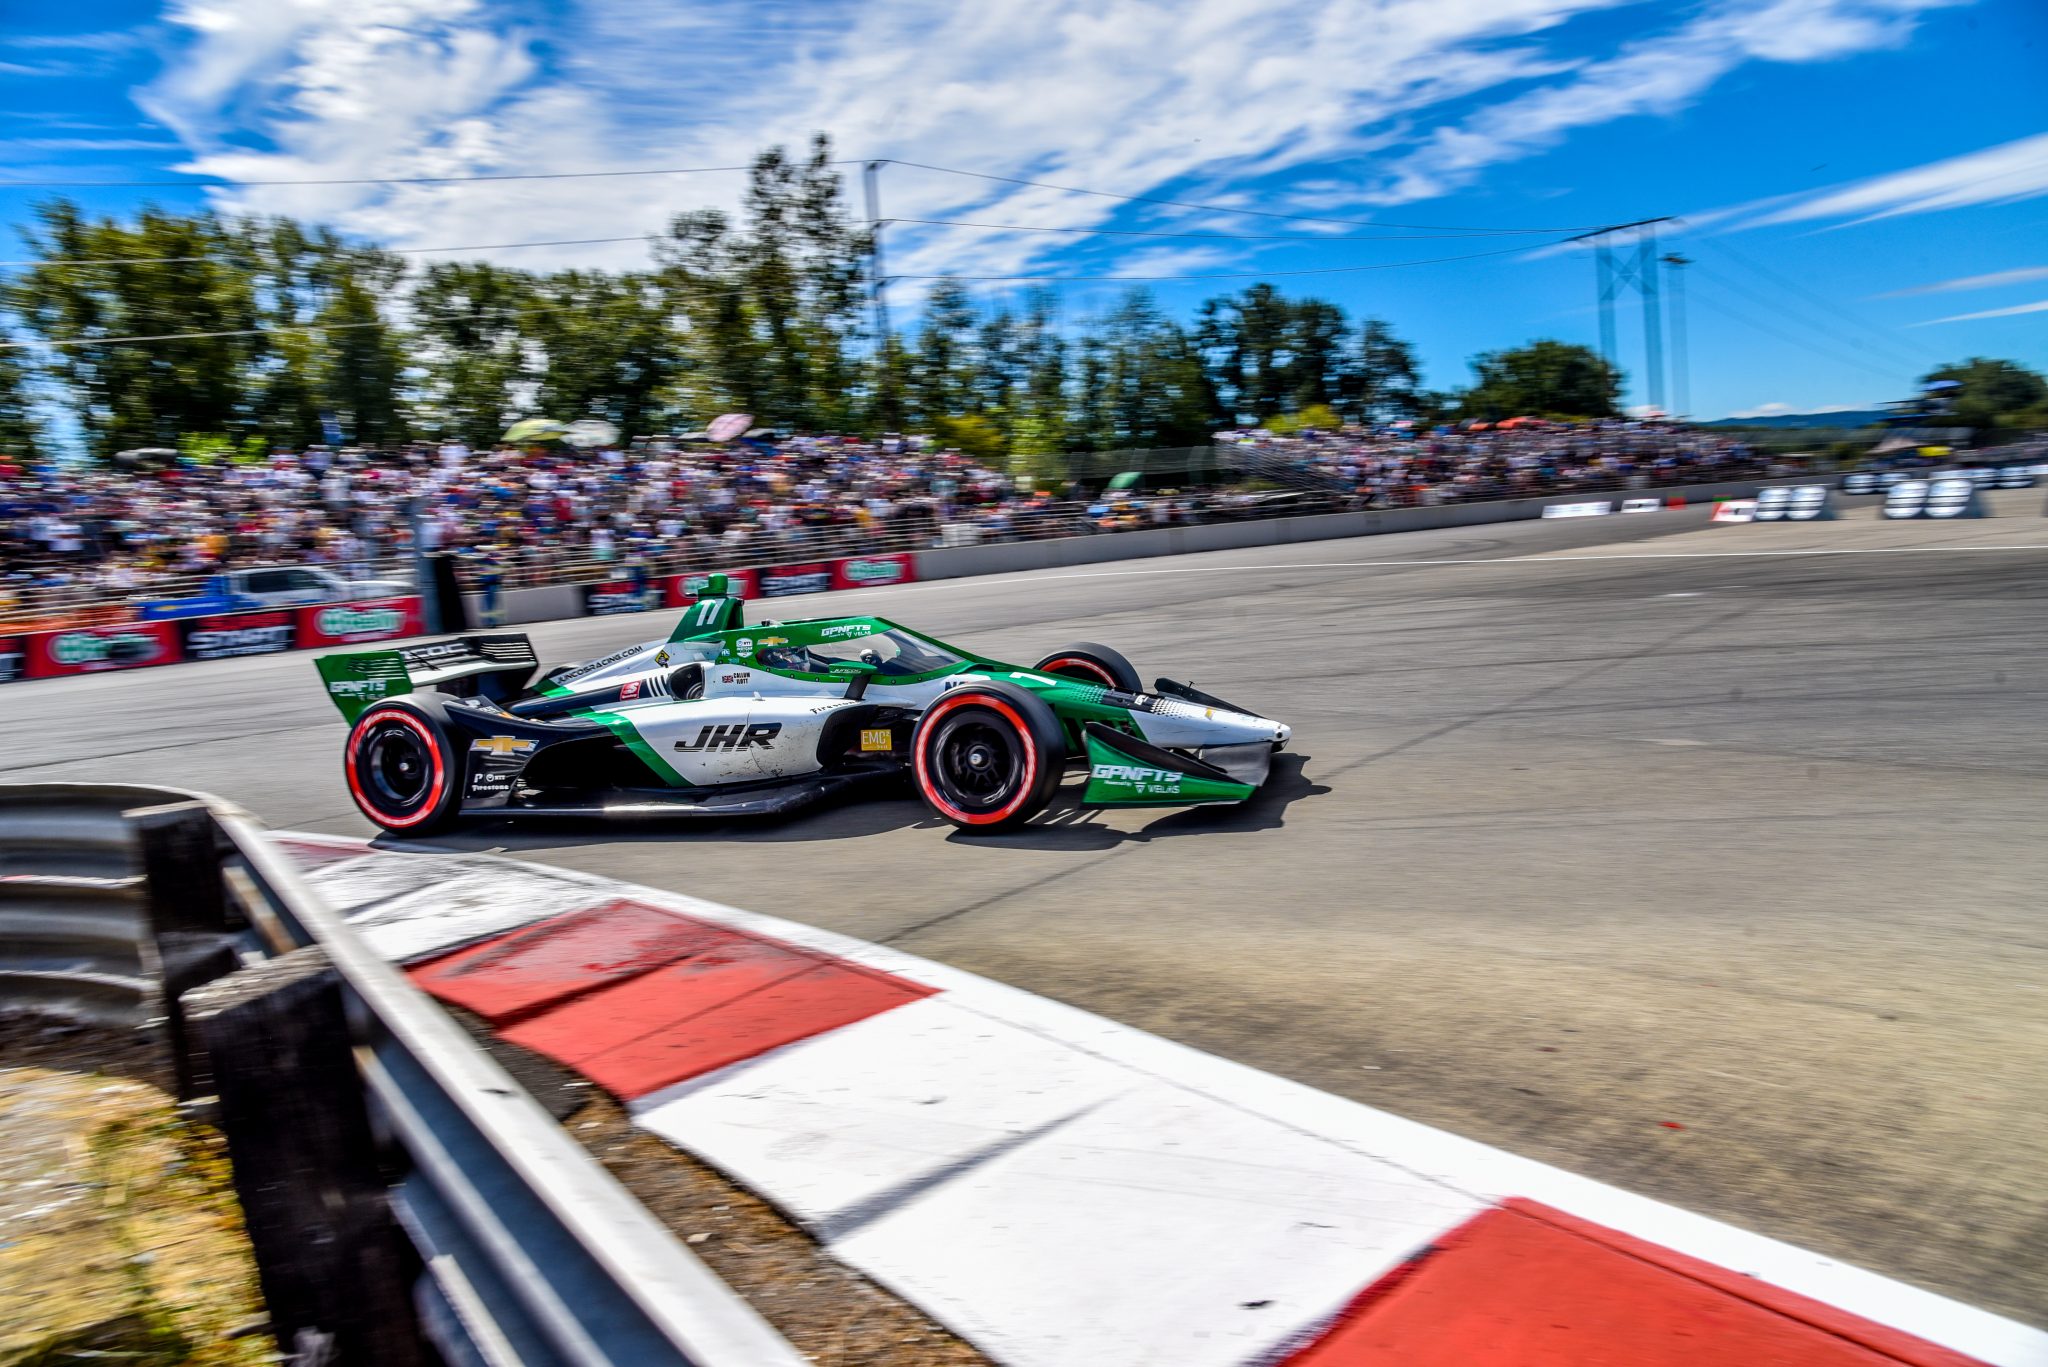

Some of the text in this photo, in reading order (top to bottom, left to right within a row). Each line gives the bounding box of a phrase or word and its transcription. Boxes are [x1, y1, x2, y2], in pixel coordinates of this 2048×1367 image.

[557, 645, 643, 683] JUNCOSRACING.COM
[673, 722, 782, 752] JHR
[1091, 763, 1184, 782] GPNFTS
[472, 784, 510, 792] Firestone
